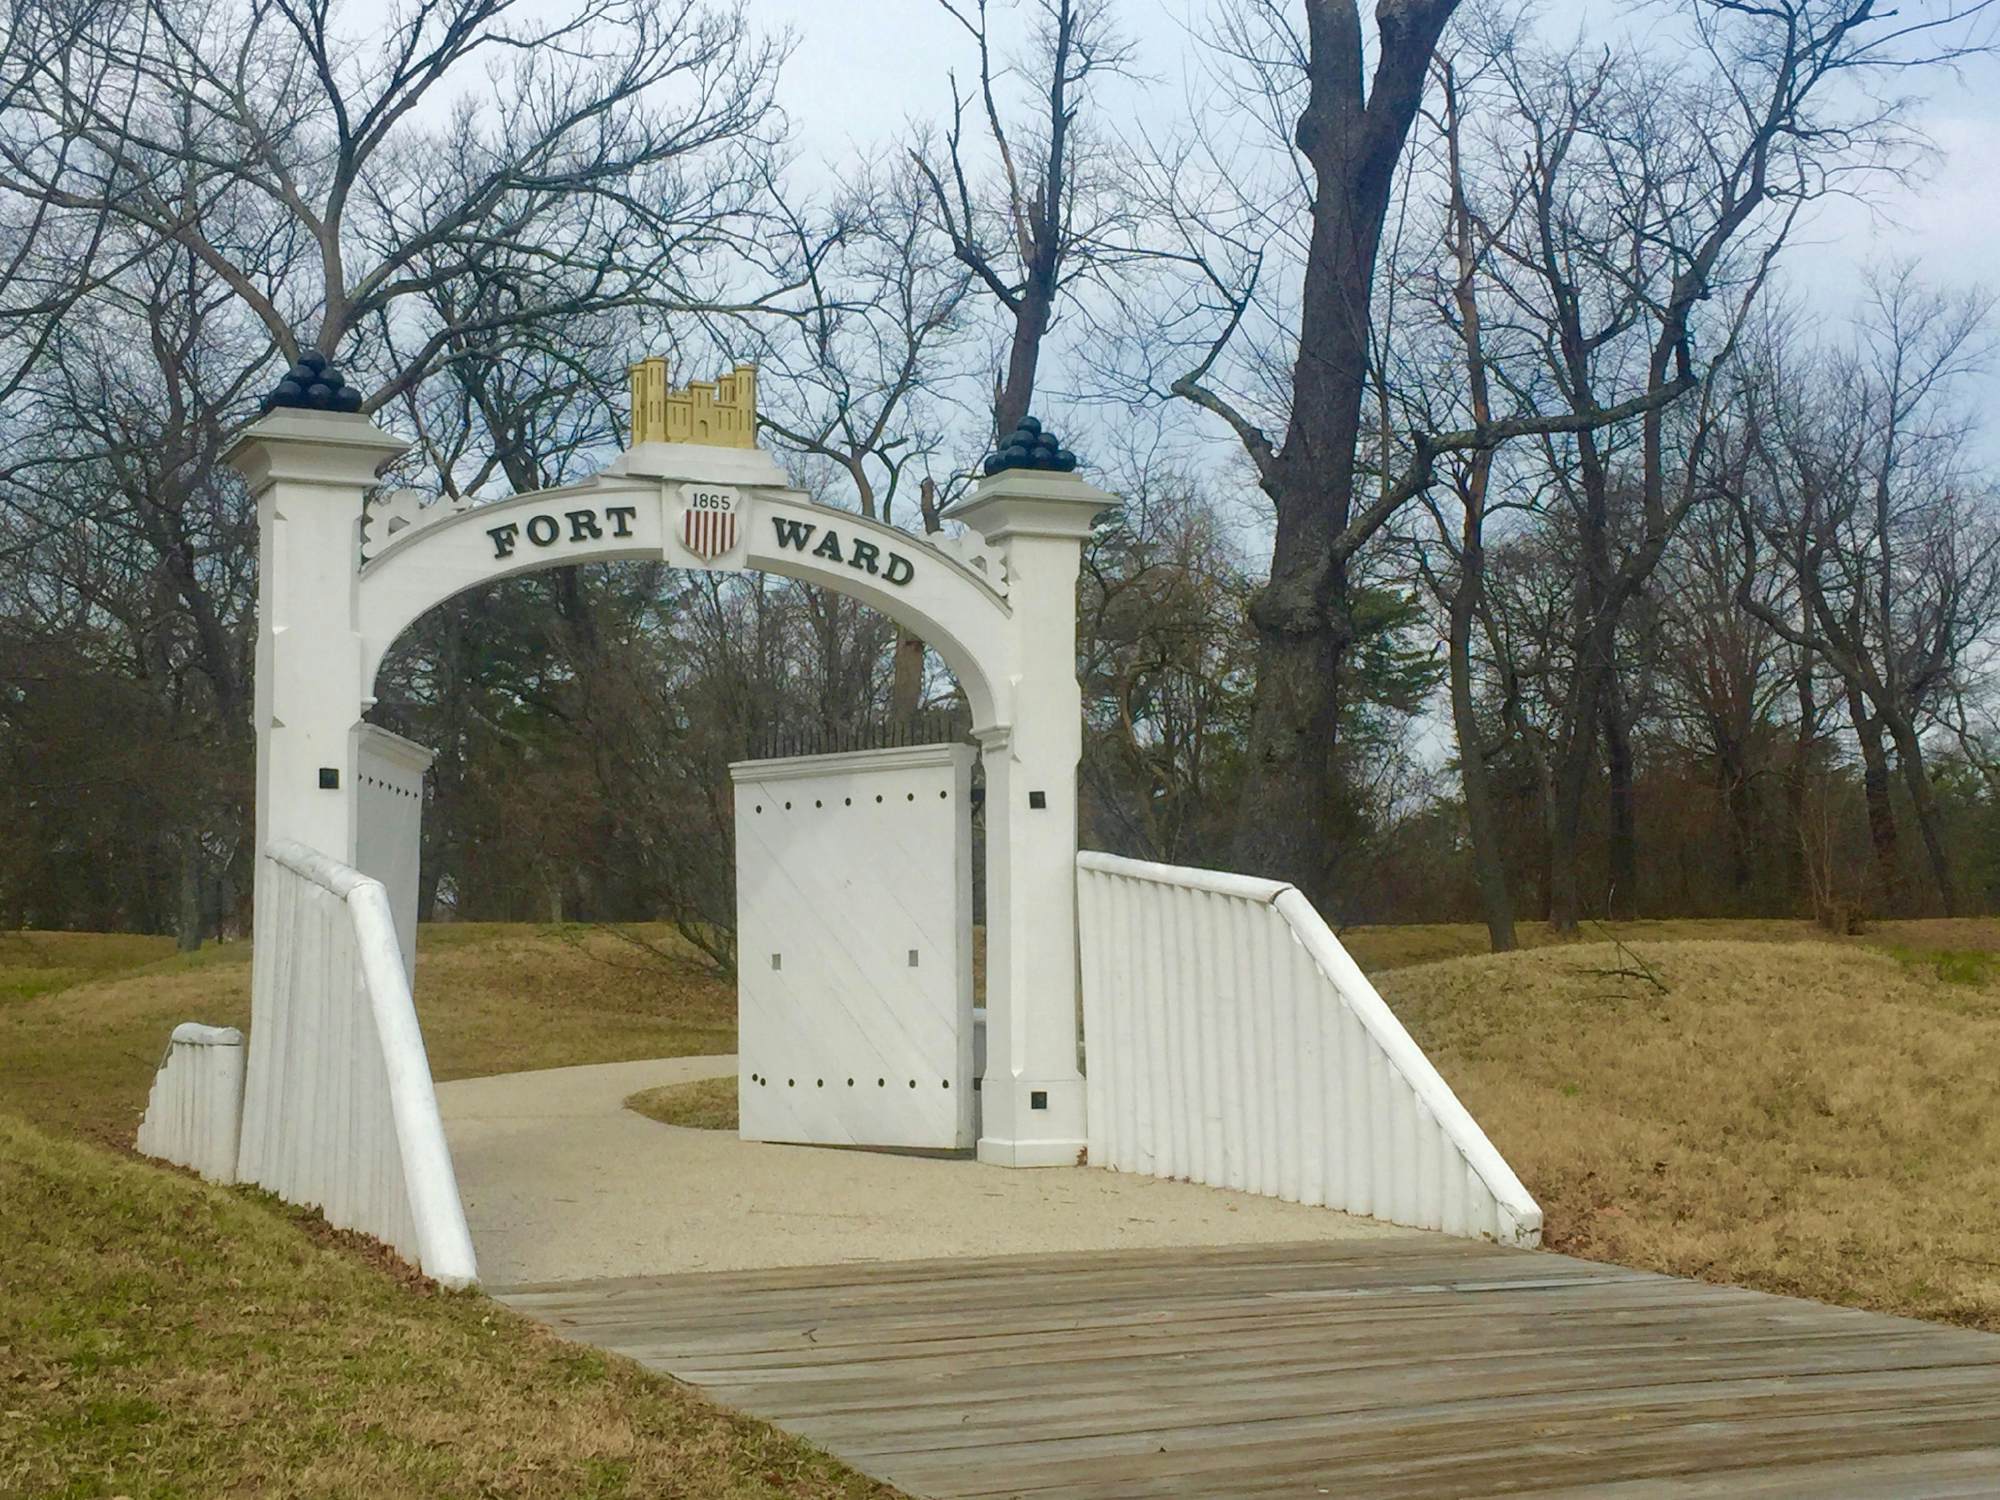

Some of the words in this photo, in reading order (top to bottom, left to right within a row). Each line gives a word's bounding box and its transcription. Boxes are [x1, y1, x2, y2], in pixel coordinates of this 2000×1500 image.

[692, 493, 731, 511] 1865
[486, 506, 637, 560] FORT
[771, 516, 915, 587] WARD
